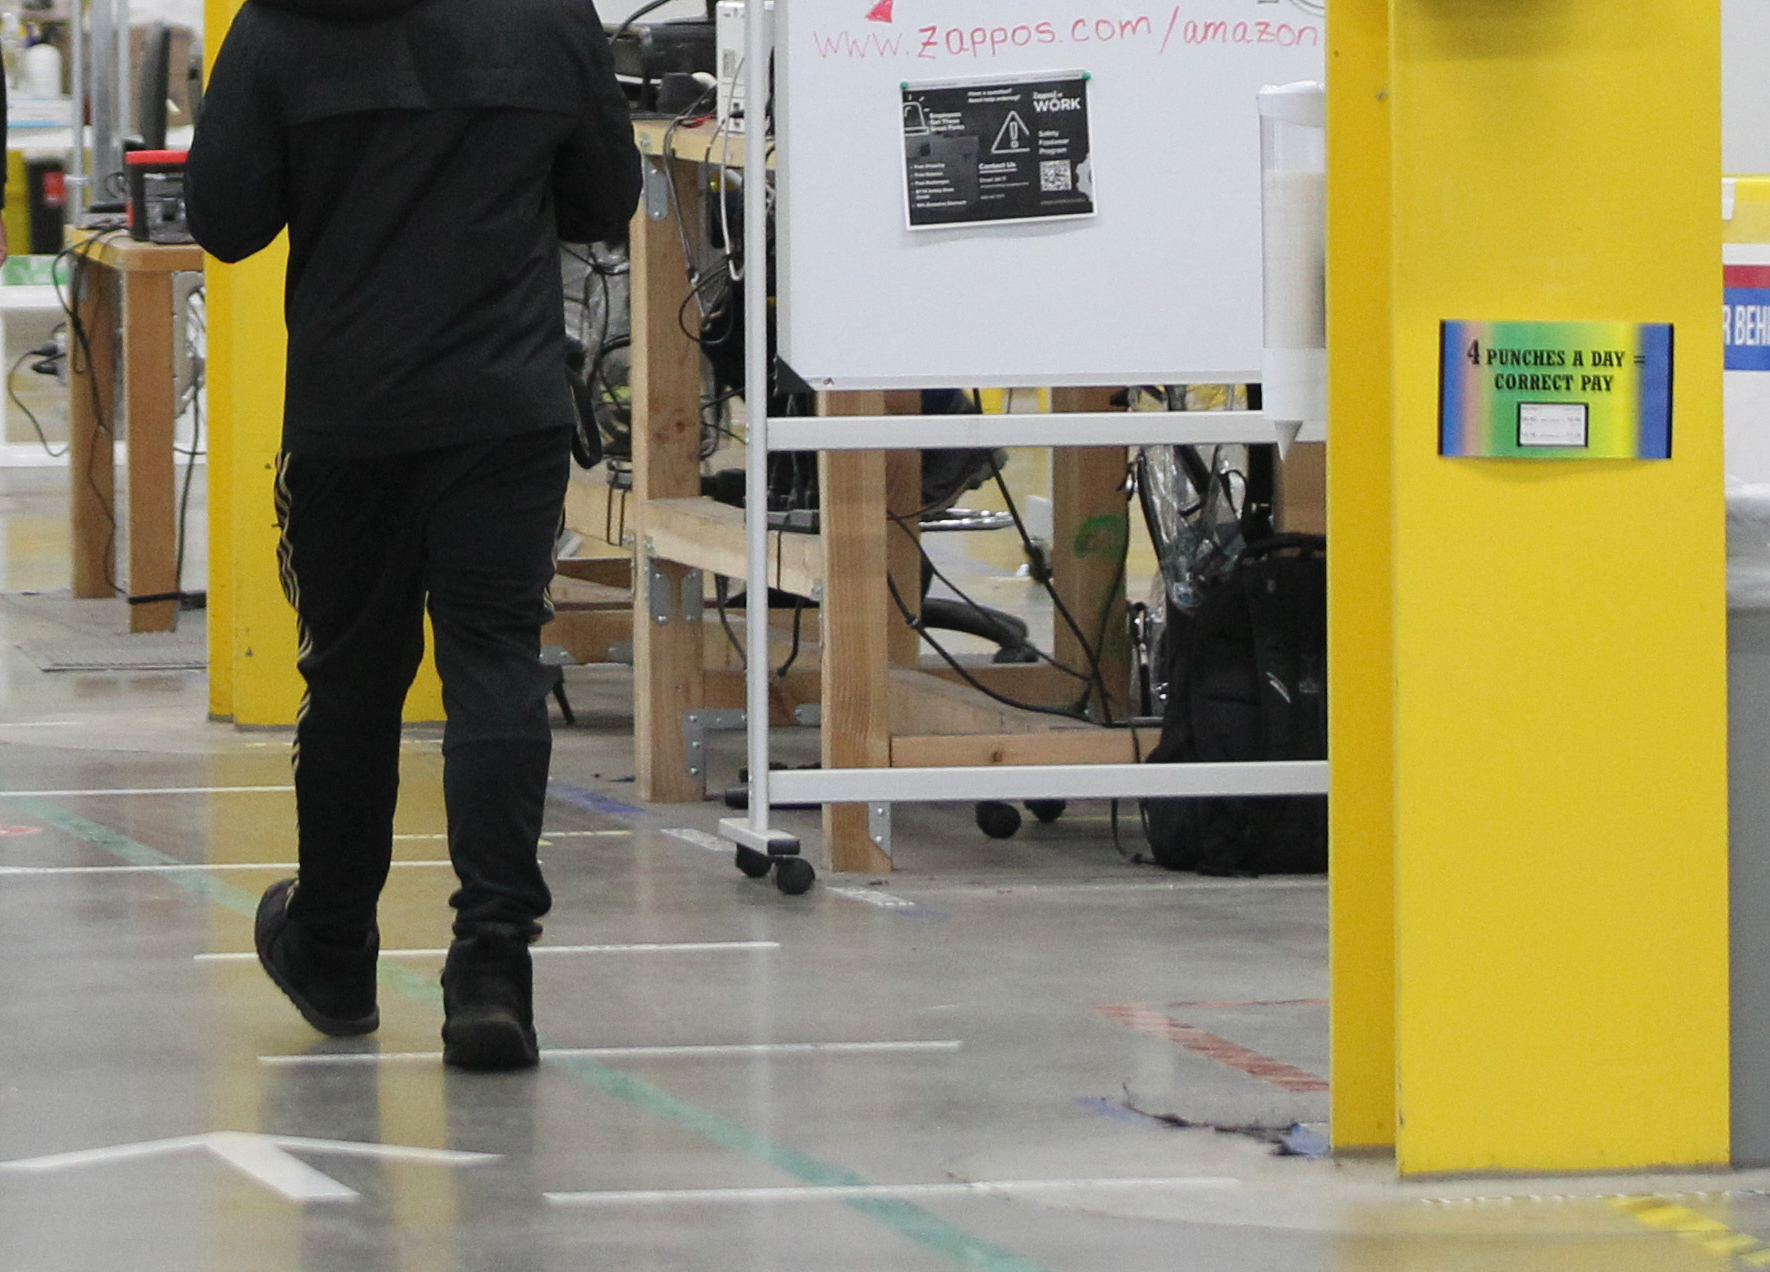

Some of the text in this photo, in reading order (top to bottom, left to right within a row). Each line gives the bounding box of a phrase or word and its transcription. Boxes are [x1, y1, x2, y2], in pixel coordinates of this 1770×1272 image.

[1033, 98, 1081, 112] WORK
[1039, 147, 1067, 155] Program
[979, 162, 1006, 170] Contact
[1467, 339, 1479, 365] 4
[1486, 349, 1565, 367] PUNCHES
[1573, 350, 1583, 367] A
[1592, 351, 1626, 367] DAY
[1495, 373, 1614, 391] CORRECT PAY
